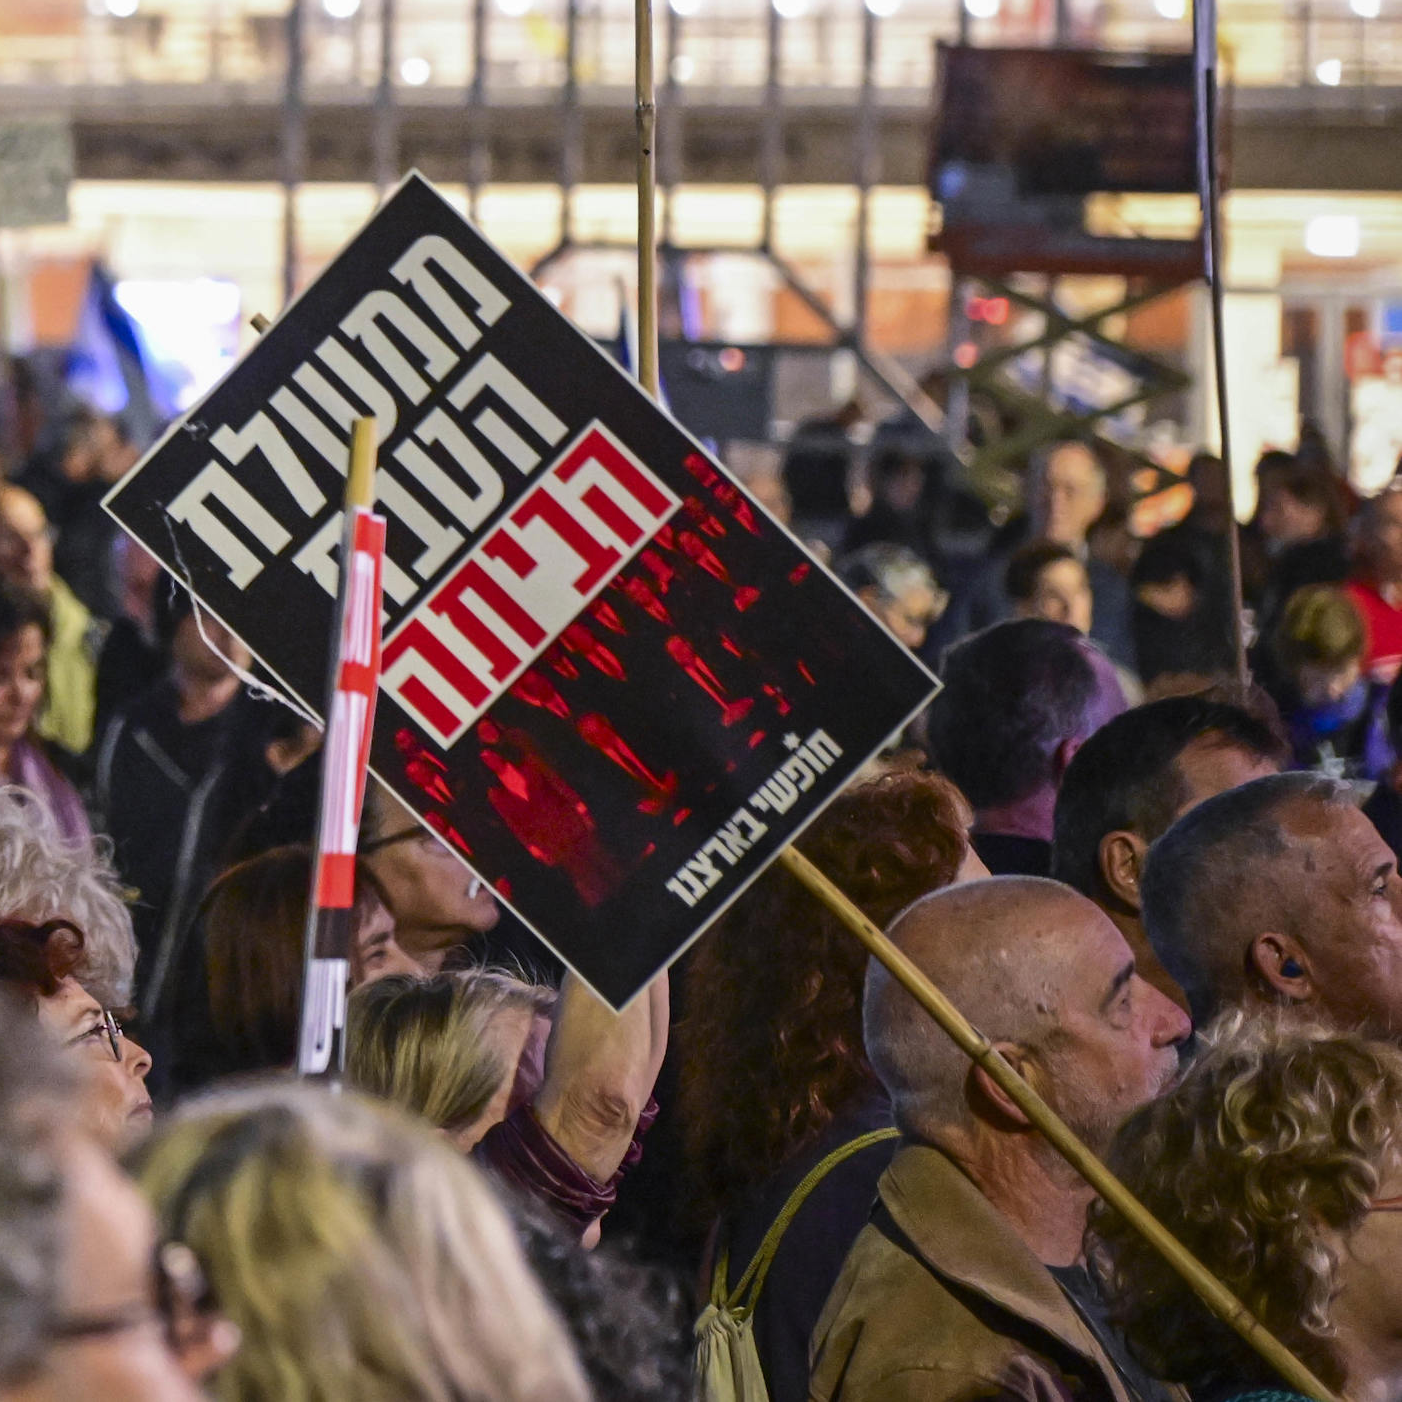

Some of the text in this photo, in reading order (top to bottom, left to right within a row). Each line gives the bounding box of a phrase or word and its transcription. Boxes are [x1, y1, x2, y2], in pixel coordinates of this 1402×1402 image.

[167, 235, 512, 591] ממשלת
[380, 428, 674, 741] הביתה
[664, 728, 844, 908] חופשי בארצנו
